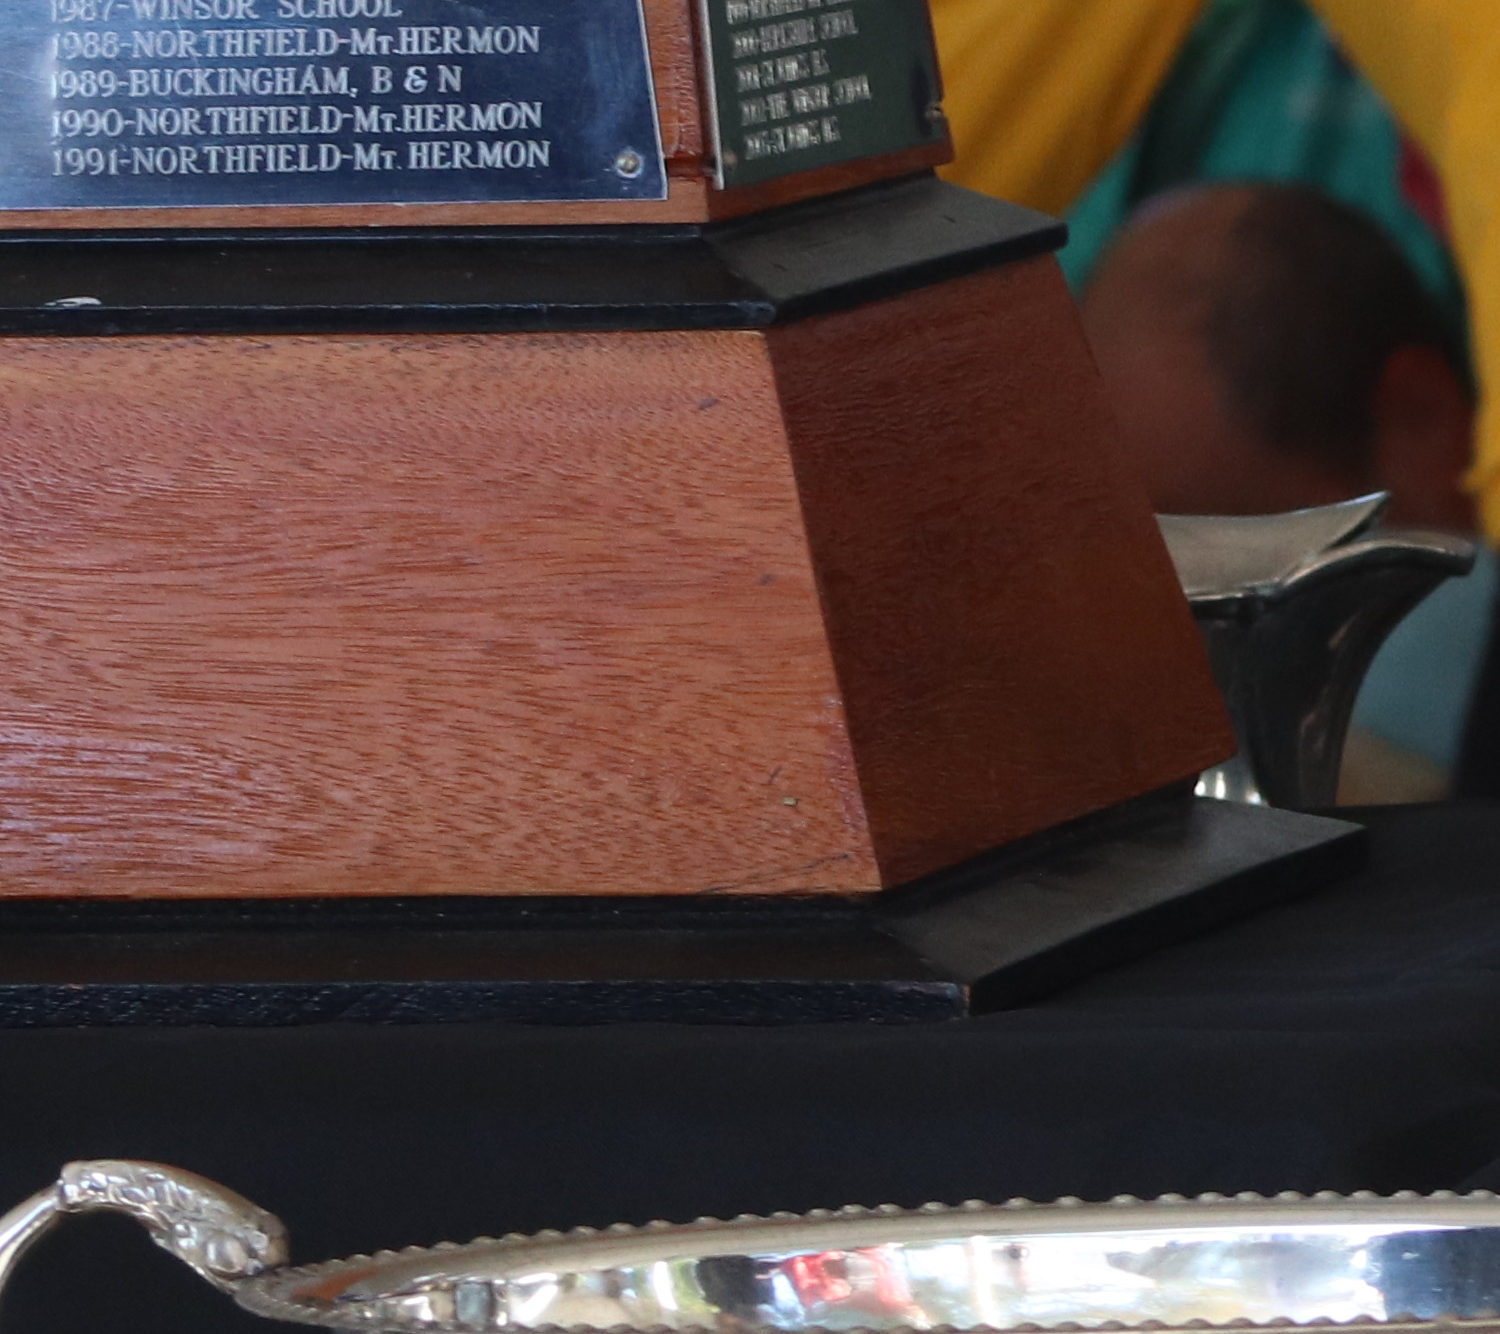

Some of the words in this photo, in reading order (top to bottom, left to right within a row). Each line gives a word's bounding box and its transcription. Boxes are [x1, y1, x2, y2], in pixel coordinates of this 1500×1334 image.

[373, 68, 392, 93] B
[405, 67, 427, 92] &
[438, 66, 463, 92] N
[409, 141, 550, 169] HERMON
